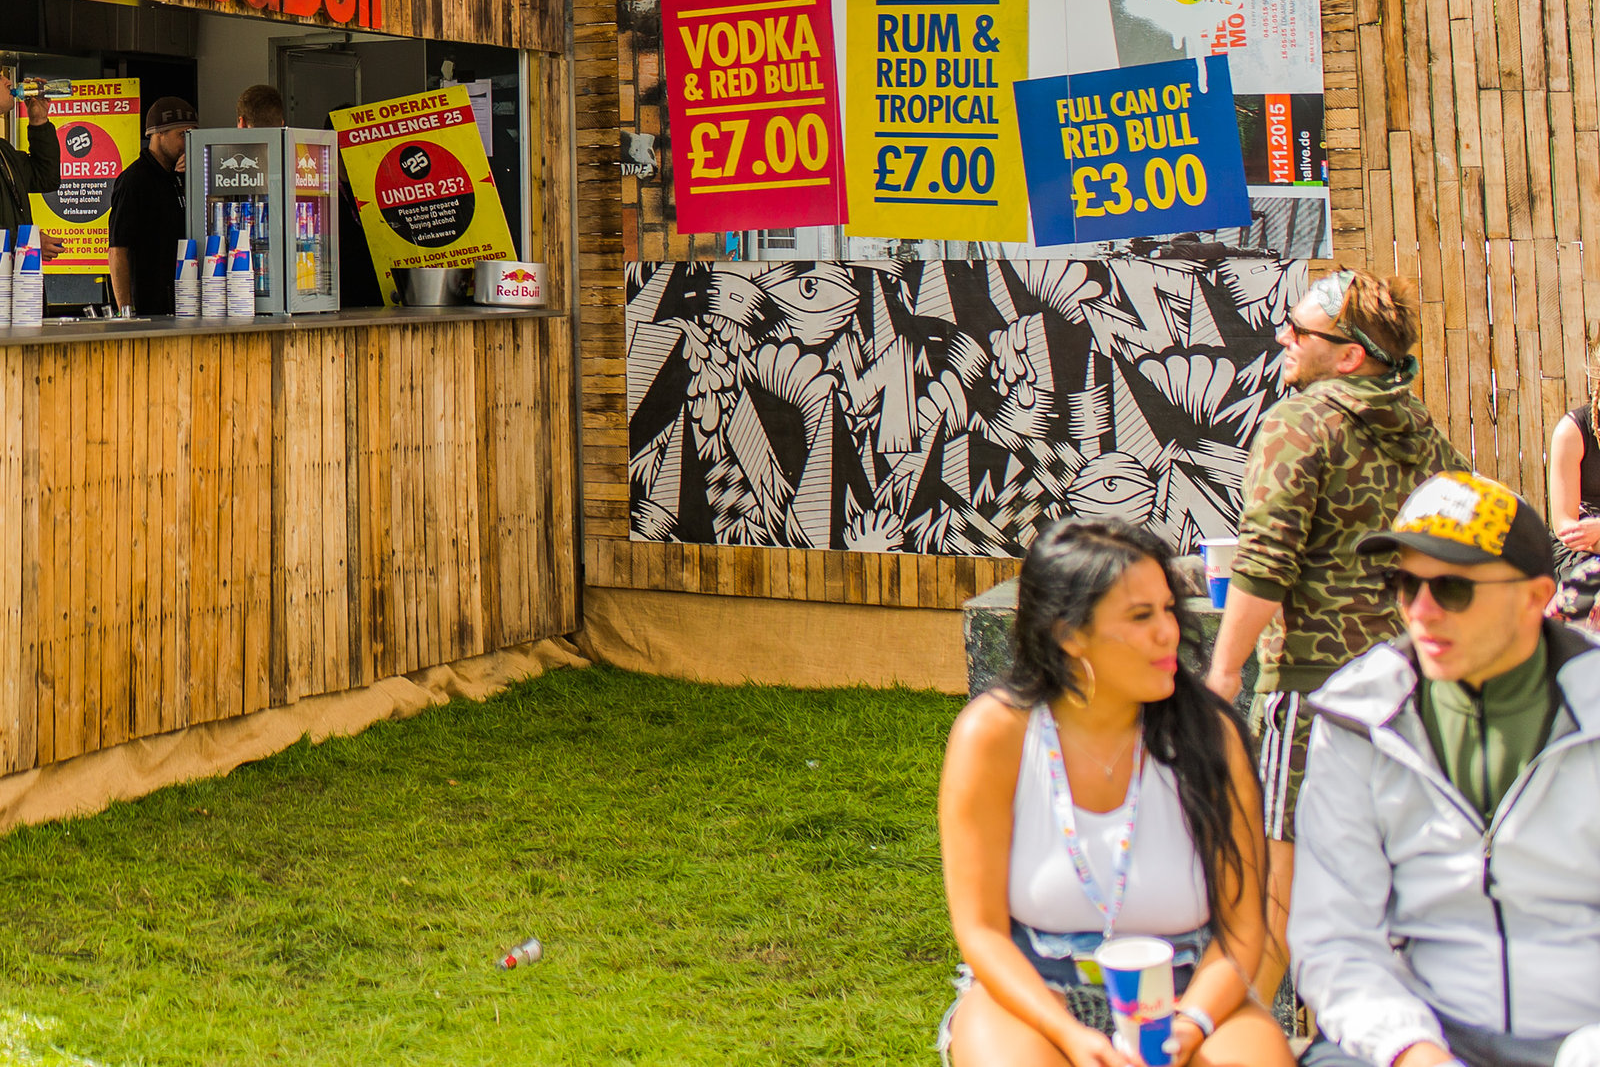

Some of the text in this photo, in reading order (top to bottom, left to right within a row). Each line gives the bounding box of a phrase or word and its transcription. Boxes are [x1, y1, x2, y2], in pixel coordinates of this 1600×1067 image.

[678, 14, 821, 69] VODKA
[878, 14, 1000, 52] RUM &
[683, 60, 825, 101] & RED BULL
[877, 58, 999, 88] RED BULL
[71, 83, 122, 96] PERATE
[1056, 82, 1192, 124] FULL CAN OF
[48, 100, 130, 114] ALLENGE 25
[351, 109, 376, 124] WE
[379, 94, 449, 118] OPERATE
[875, 94, 999, 124] TROPICAL
[349, 114, 440, 143] CHALLENGE
[443, 110, 463, 124] 25
[1061, 112, 1199, 159] RED BULL
[687, 112, 829, 179] £7.00
[93, 161, 117, 175] 25?
[215, 172, 264, 187] Red Bull
[296, 173, 319, 187] Red Bull
[873, 145, 995, 194] £7.00
[381, 177, 465, 204] UNDER 25?
[1070, 153, 1208, 218] £3.00
[398, 199, 460, 216] Please be prepared
[405, 208, 456, 223] to show ID when
[409, 216, 456, 230] buying alcohol
[417, 228, 456, 241] drinkaware
[393, 243, 493, 267] IF YOU LOOK UNDER 25
[446, 260, 459, 268] BE
[496, 285, 540, 298] Red Bull
